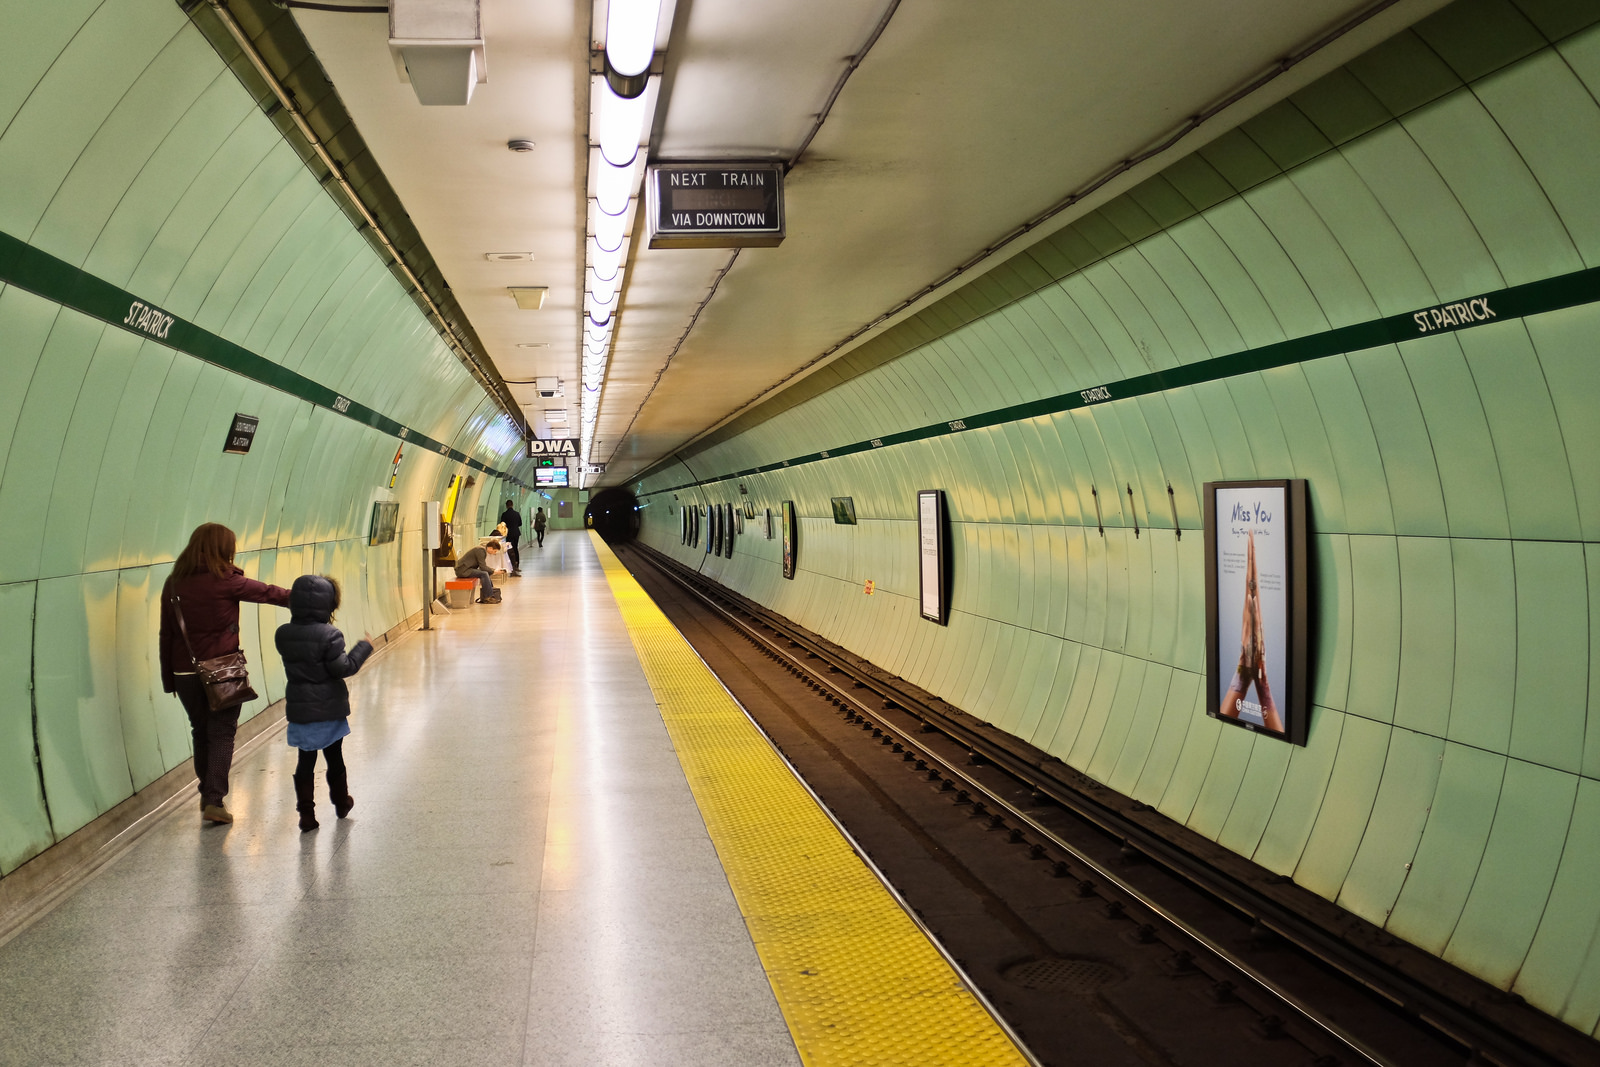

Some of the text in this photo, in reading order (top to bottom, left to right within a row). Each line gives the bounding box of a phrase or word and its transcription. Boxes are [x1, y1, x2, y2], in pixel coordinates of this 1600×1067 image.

[670, 173, 764, 186] NEXT TRAIN
[672, 212, 765, 226] VIA DOWNTOWN
[531, 440, 576, 453] DWA
[1231, 501, 1272, 524] Miss You
